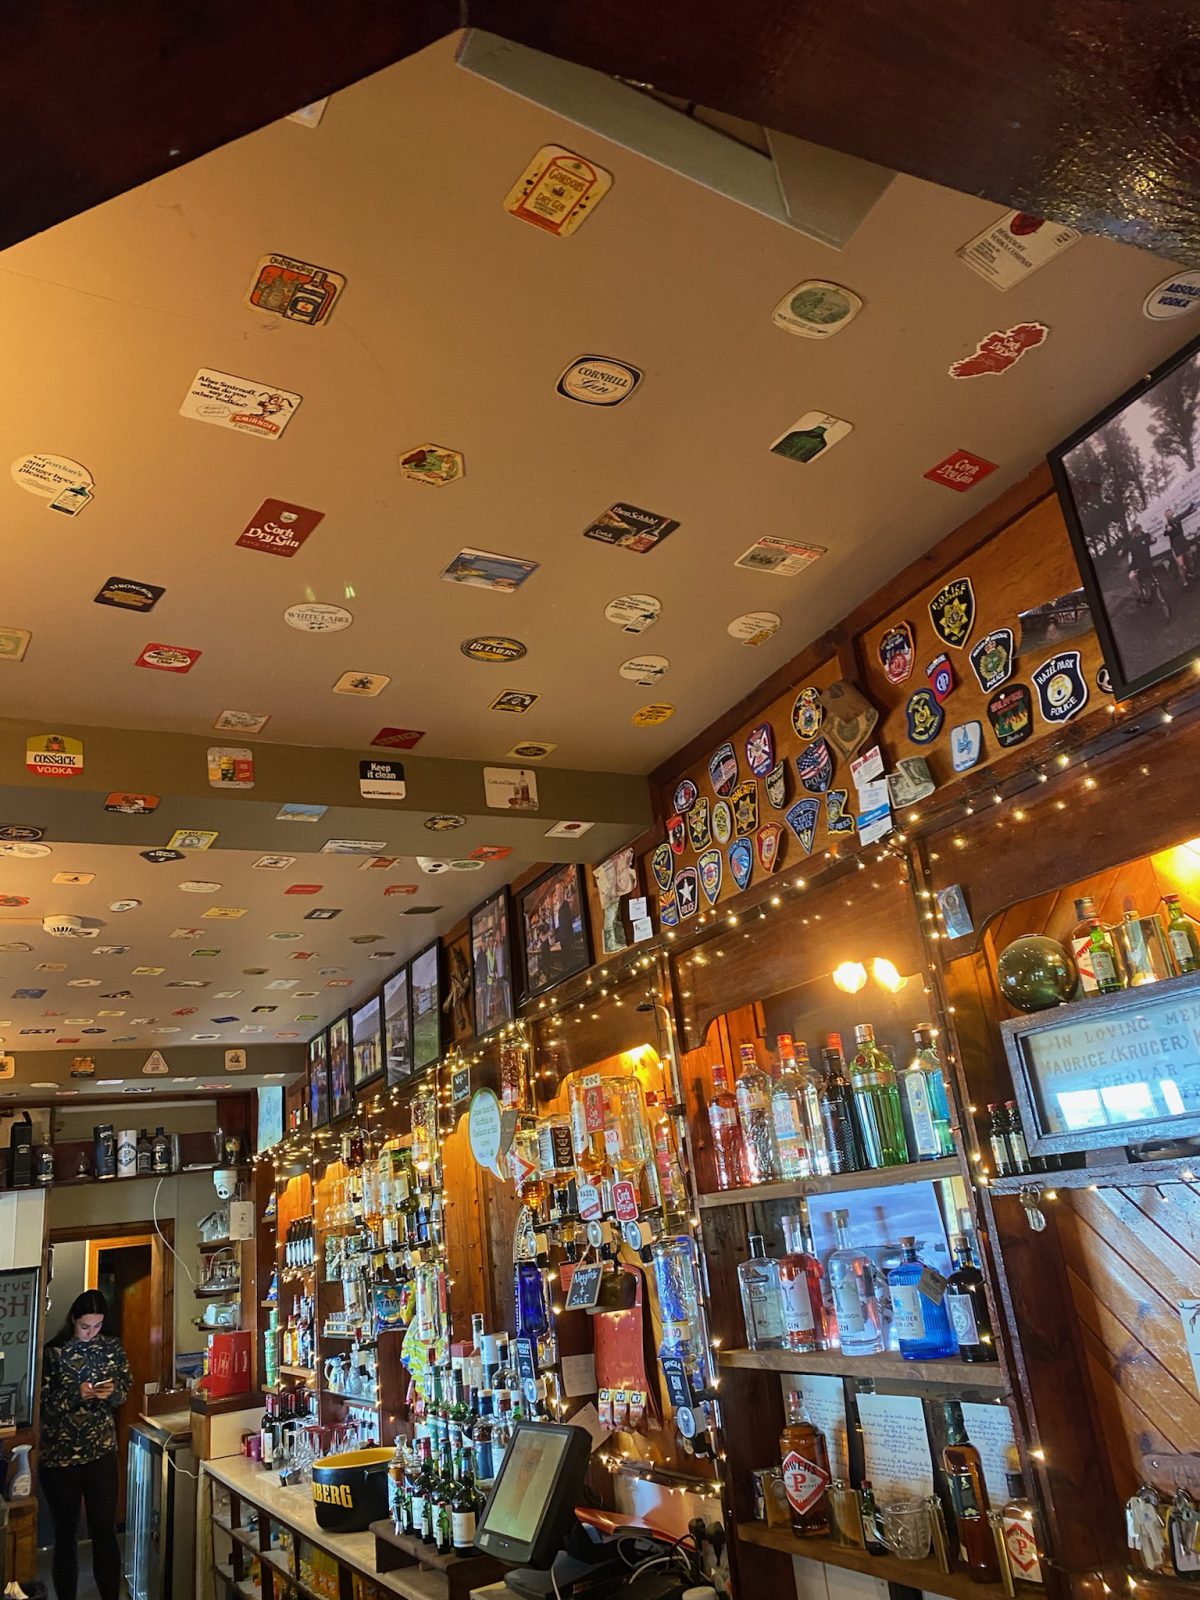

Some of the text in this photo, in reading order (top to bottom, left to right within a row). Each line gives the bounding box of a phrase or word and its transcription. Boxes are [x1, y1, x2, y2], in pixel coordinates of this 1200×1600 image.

[1158, 296, 1192, 308] VODKA
[198, 376, 219, 387] After
[578, 366, 628, 387] CORNHILL
[192, 390, 214, 400] other
[200, 383, 248, 399] what do you
[208, 390, 220, 398] say
[234, 414, 278, 434] SMIRNOFF
[26, 459, 47, 469] and
[244, 527, 275, 544] Dry
[271, 535, 300, 548] Gin
[263, 522, 295, 539] Cork
[931, 582, 967, 611] POLICE
[287, 611, 351, 625] WHITE LABEL
[469, 642, 518, 656] BULMERS
[1036, 659, 1075, 685] HAZEL PARK
[1049, 696, 1078, 716] POLICE
[37, 766, 73, 775] VODKA
[367, 770, 397, 780] it clean
[371, 763, 391, 773] Keep
[804, 763, 831, 789] POLICE
[792, 812, 814, 827] STATE
[680, 902, 695, 914] POLICE
[1055, 1034, 1073, 1050] IN
[1085, 1017, 1150, 1044] LOVING
[1041, 1050, 1107, 1075] MAURICE
[617, 1188, 631, 1203] Cork
[0, 1281, 31, 1293] rve
[571, 1294, 590, 1306] SALE
[663, 1360, 683, 1370] DINGLE
[785, 1461, 815, 1475] OWERS
[791, 1473, 807, 1492] P
[312, 1482, 353, 1508] BERG
[1015, 1538, 1028, 1556] P
